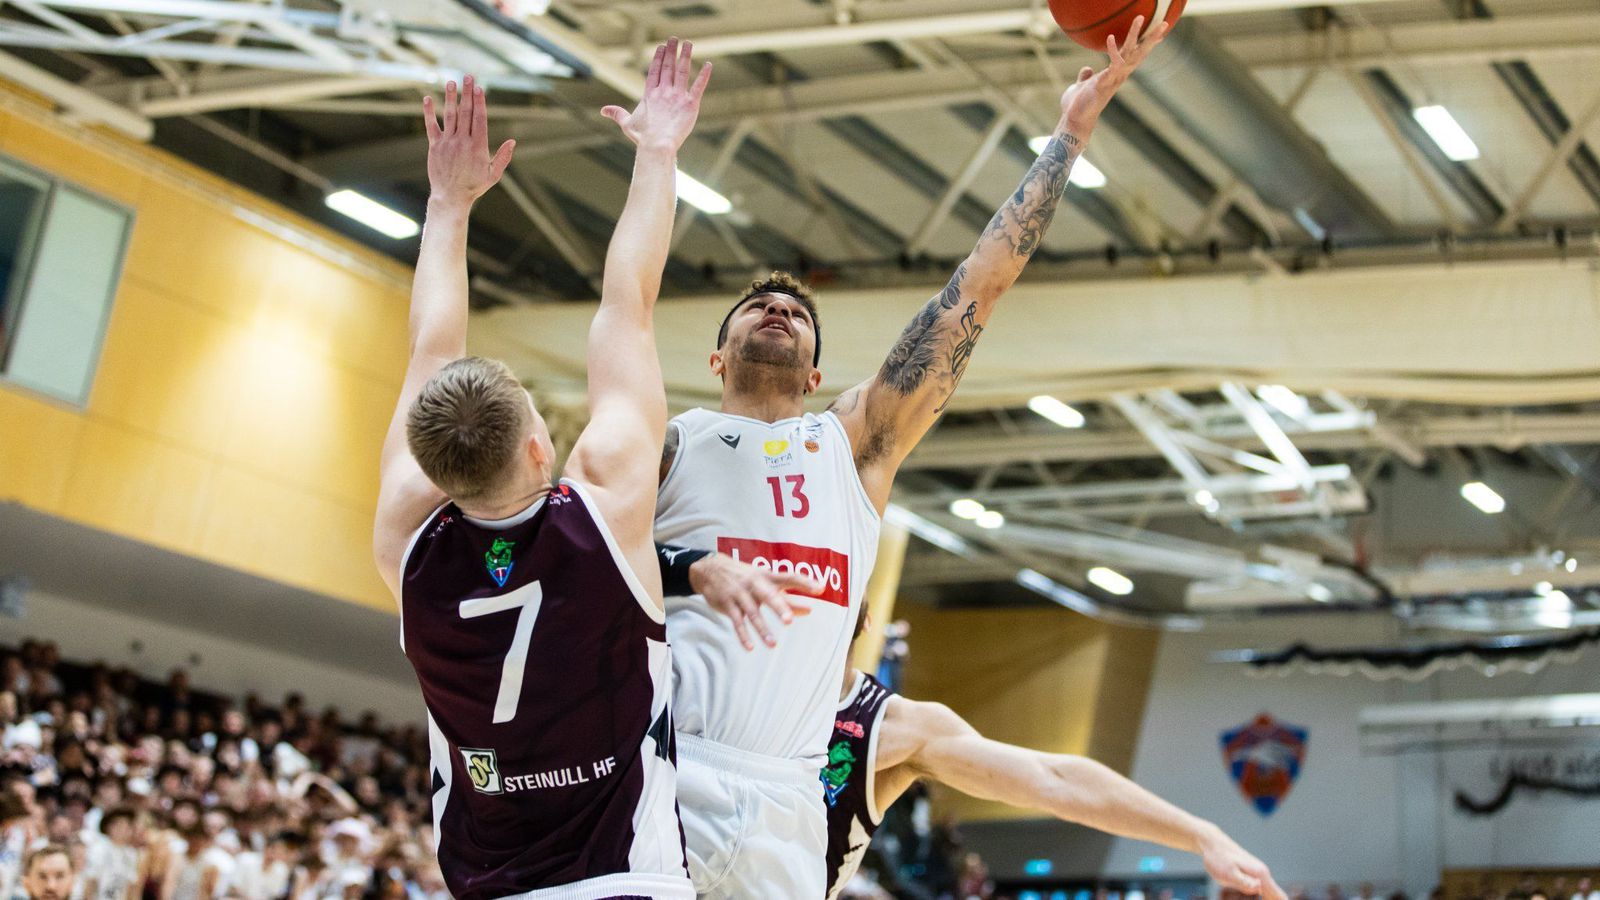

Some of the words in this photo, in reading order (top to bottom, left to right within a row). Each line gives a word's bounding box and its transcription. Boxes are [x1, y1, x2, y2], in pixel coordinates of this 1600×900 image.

[766, 474, 810, 519] 13
[459, 580, 543, 724] 7
[504, 766, 589, 792] STEINULL
[593, 756, 616, 779] HF
